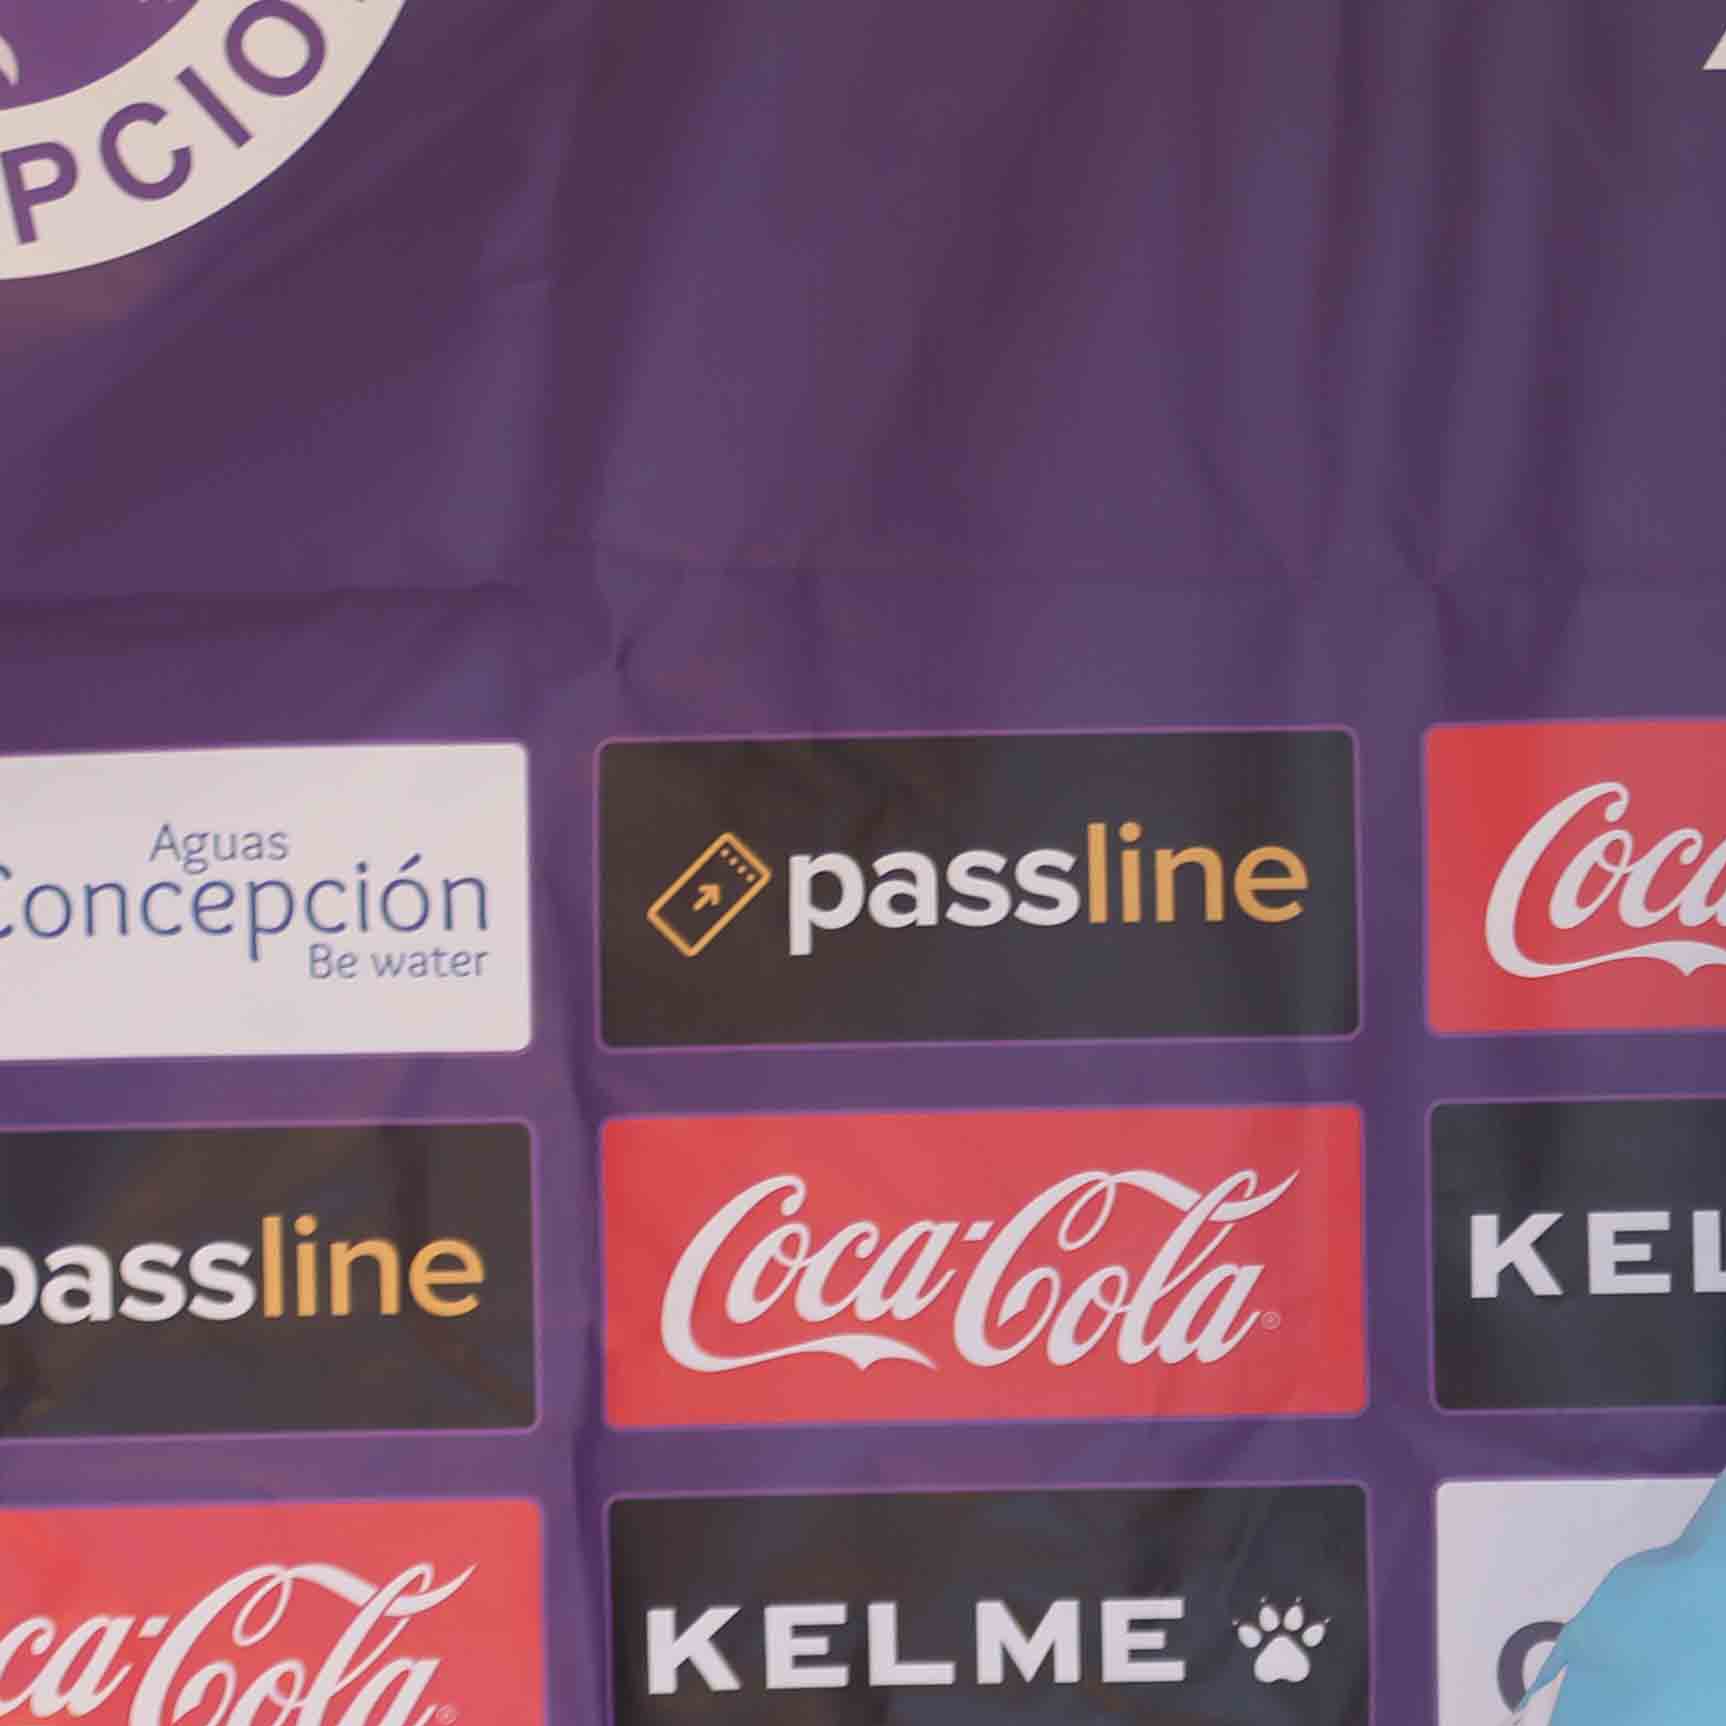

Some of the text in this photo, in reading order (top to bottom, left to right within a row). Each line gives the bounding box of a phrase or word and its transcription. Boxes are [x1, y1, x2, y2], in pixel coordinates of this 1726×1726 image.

[150, 823, 290, 876] Aguas
[789, 822, 1309, 956] passline
[0, 853, 489, 962] oncepción
[309, 943, 489, 979] Be water
[661, 1169, 1299, 1372] Coca-Cola
[647, 1598, 1187, 1696] KELME
